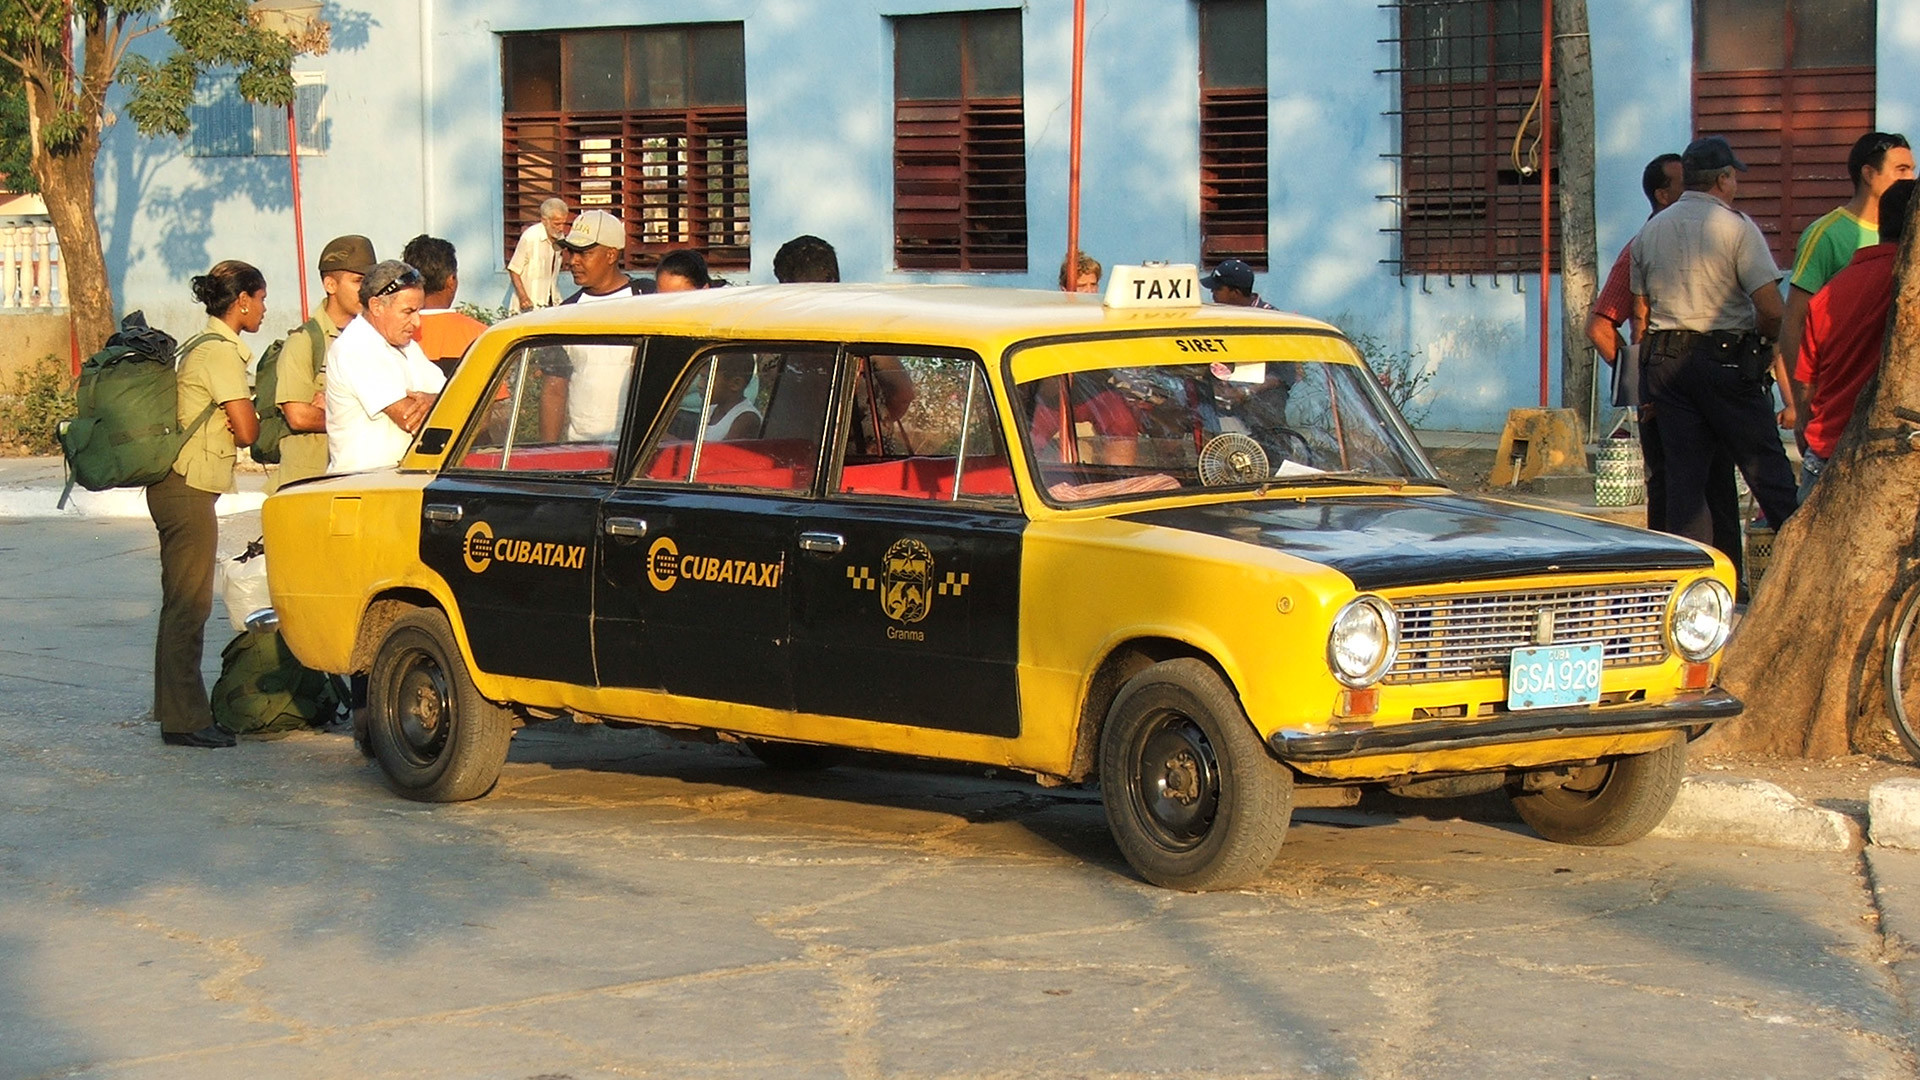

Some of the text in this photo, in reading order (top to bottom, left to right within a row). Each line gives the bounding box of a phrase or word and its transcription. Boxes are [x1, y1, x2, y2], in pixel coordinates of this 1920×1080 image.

[1133, 279, 1191, 299] TAXI
[1176, 339, 1228, 352] SIRET
[494, 538, 587, 569] CUBATAXI
[680, 555, 780, 588] CUBATAXI
[886, 626, 925, 641] Granma
[1549, 648, 1571, 661] CUBA
